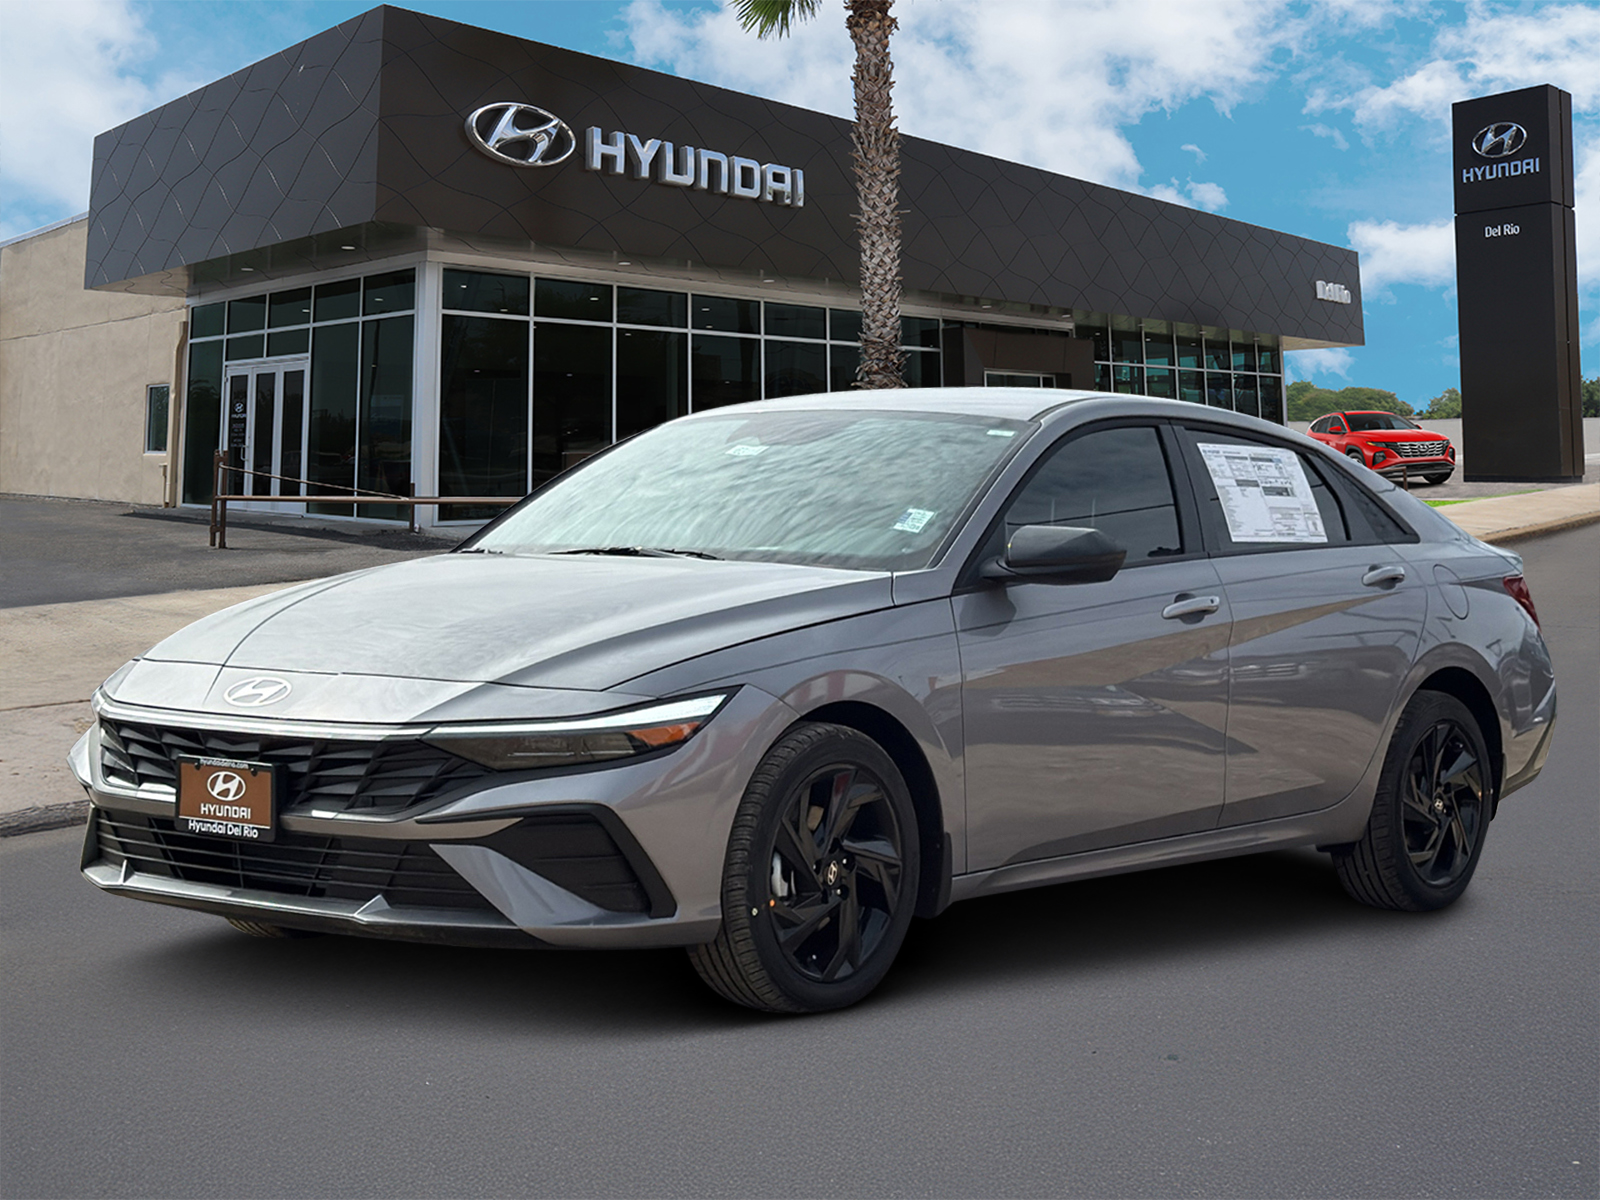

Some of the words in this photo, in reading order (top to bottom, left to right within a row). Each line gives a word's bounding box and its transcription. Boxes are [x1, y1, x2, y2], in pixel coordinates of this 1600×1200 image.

[585, 125, 804, 208] HYUNDAI
[1462, 157, 1540, 183] HYUNDAI
[1484, 225, 1501, 238] Del
[1503, 223, 1520, 235] Rio
[200, 803, 251, 819] HYUNDAI
[188, 819, 226, 834] Hyundai
[227, 823, 242, 836] Del
[243, 825, 258, 838] Rio
